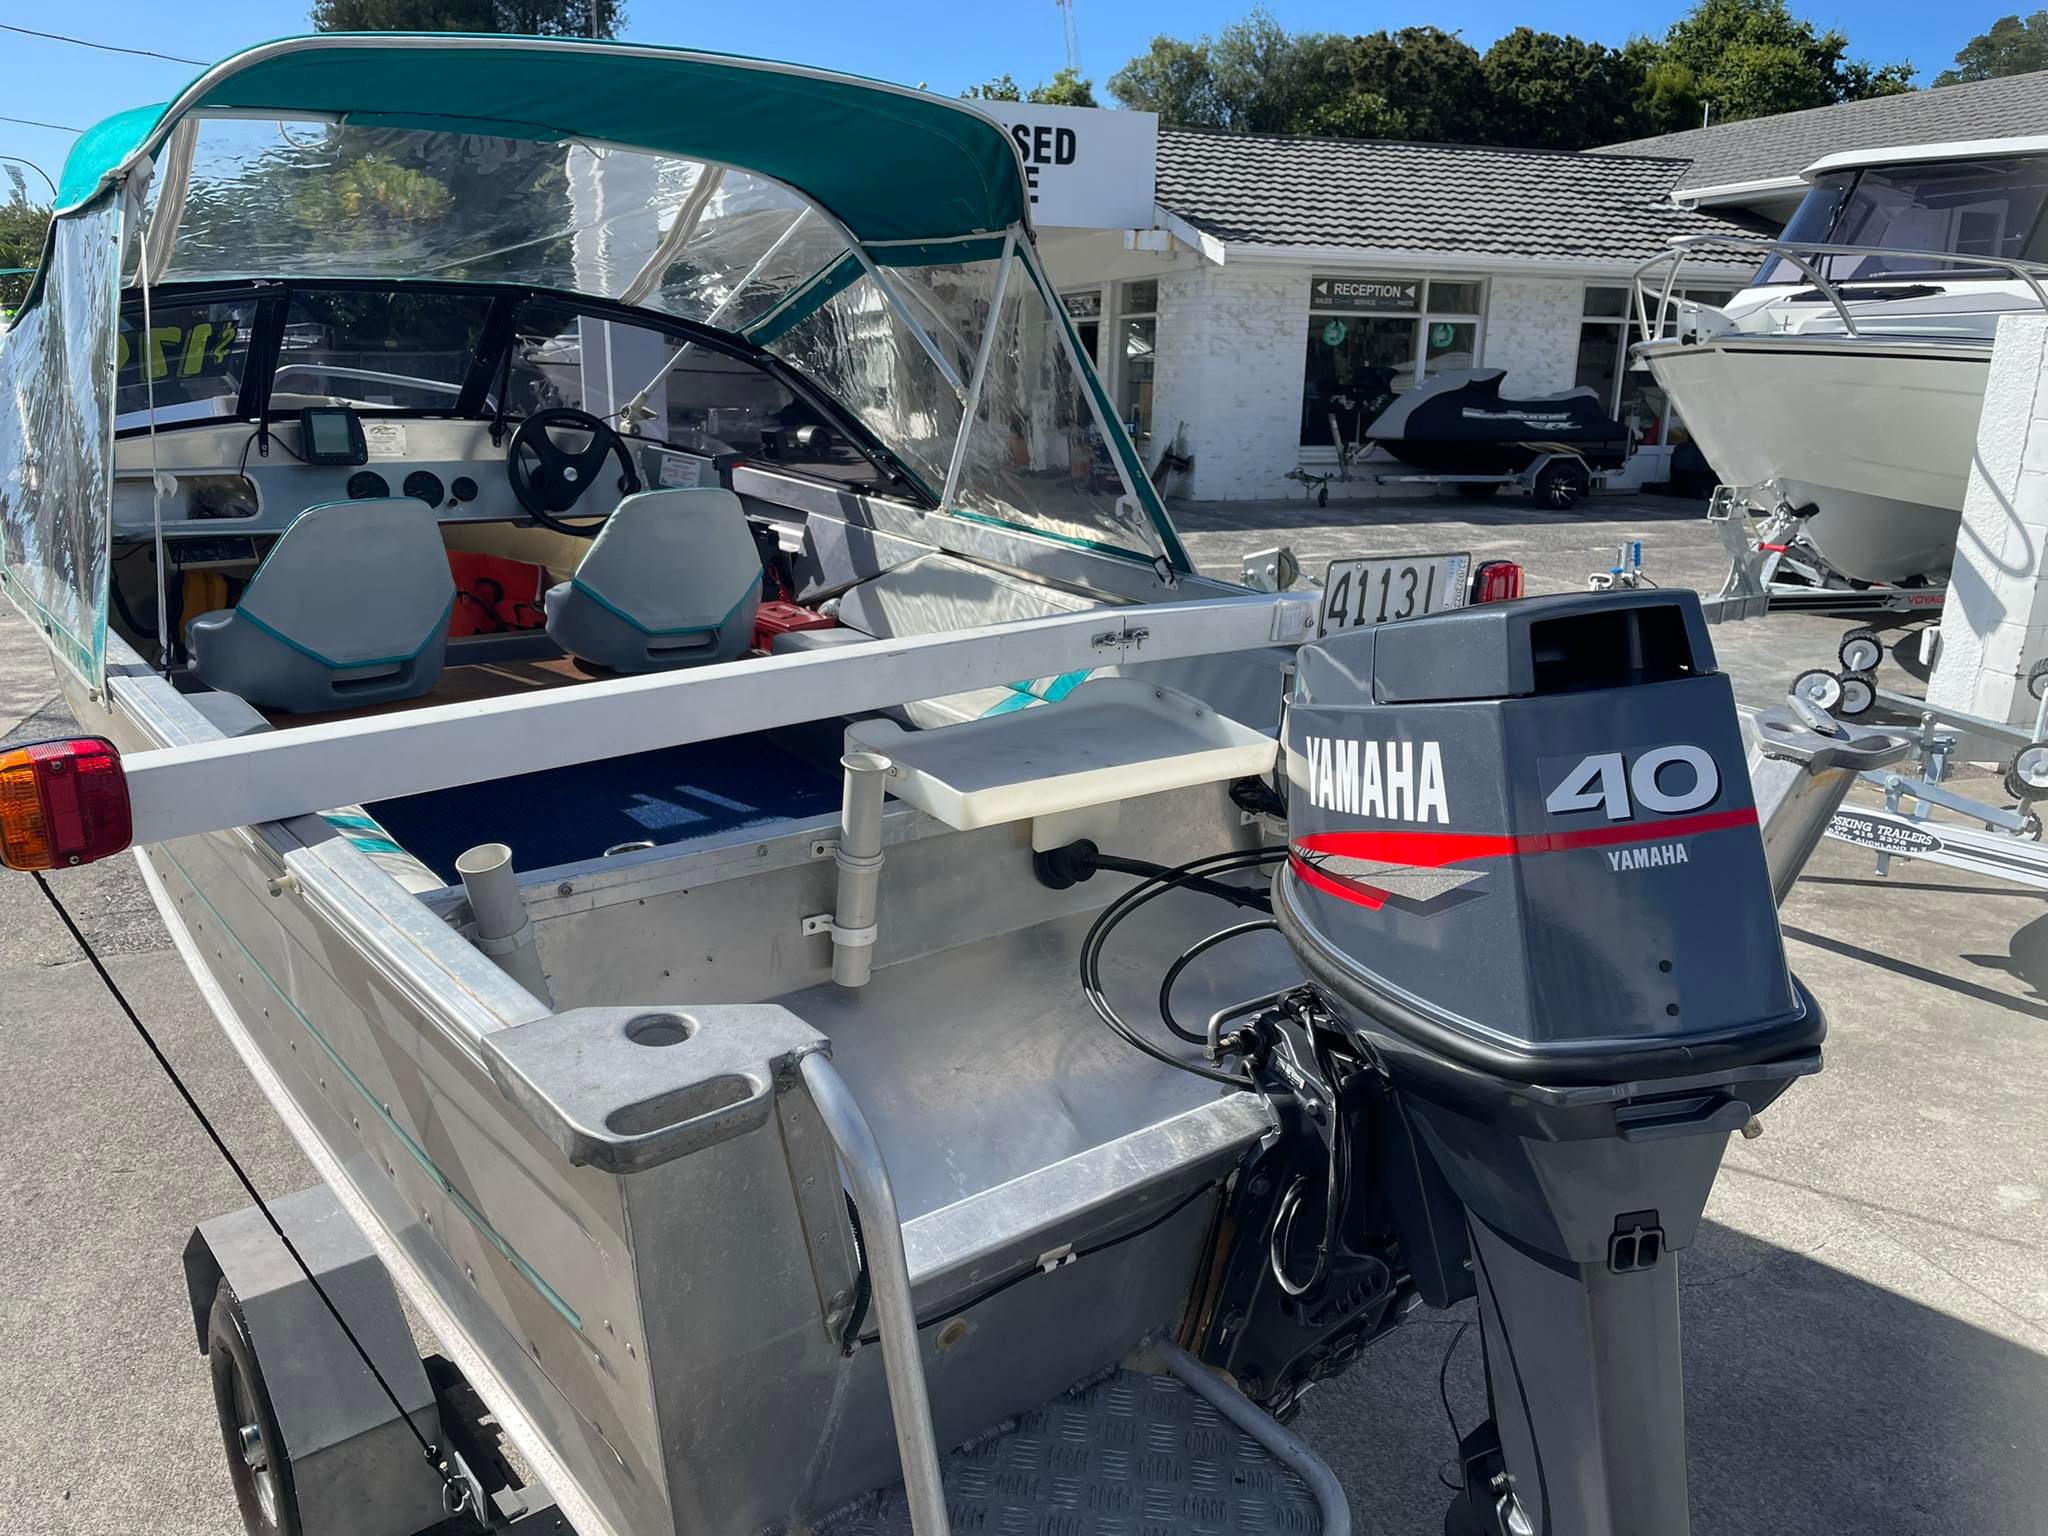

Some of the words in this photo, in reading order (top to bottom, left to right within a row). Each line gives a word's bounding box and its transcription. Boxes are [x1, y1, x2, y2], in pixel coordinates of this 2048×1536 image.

[1003, 123, 1077, 166] SED
[1333, 283, 1401, 298] RECEPTION
[1306, 735, 1450, 825] YAMAHA
[1546, 744, 1722, 822] 40
[1855, 837, 1907, 852] AUCKLAND
[1877, 825, 1934, 846] TRAILERS
[1608, 843, 1689, 872] YAMAHA
